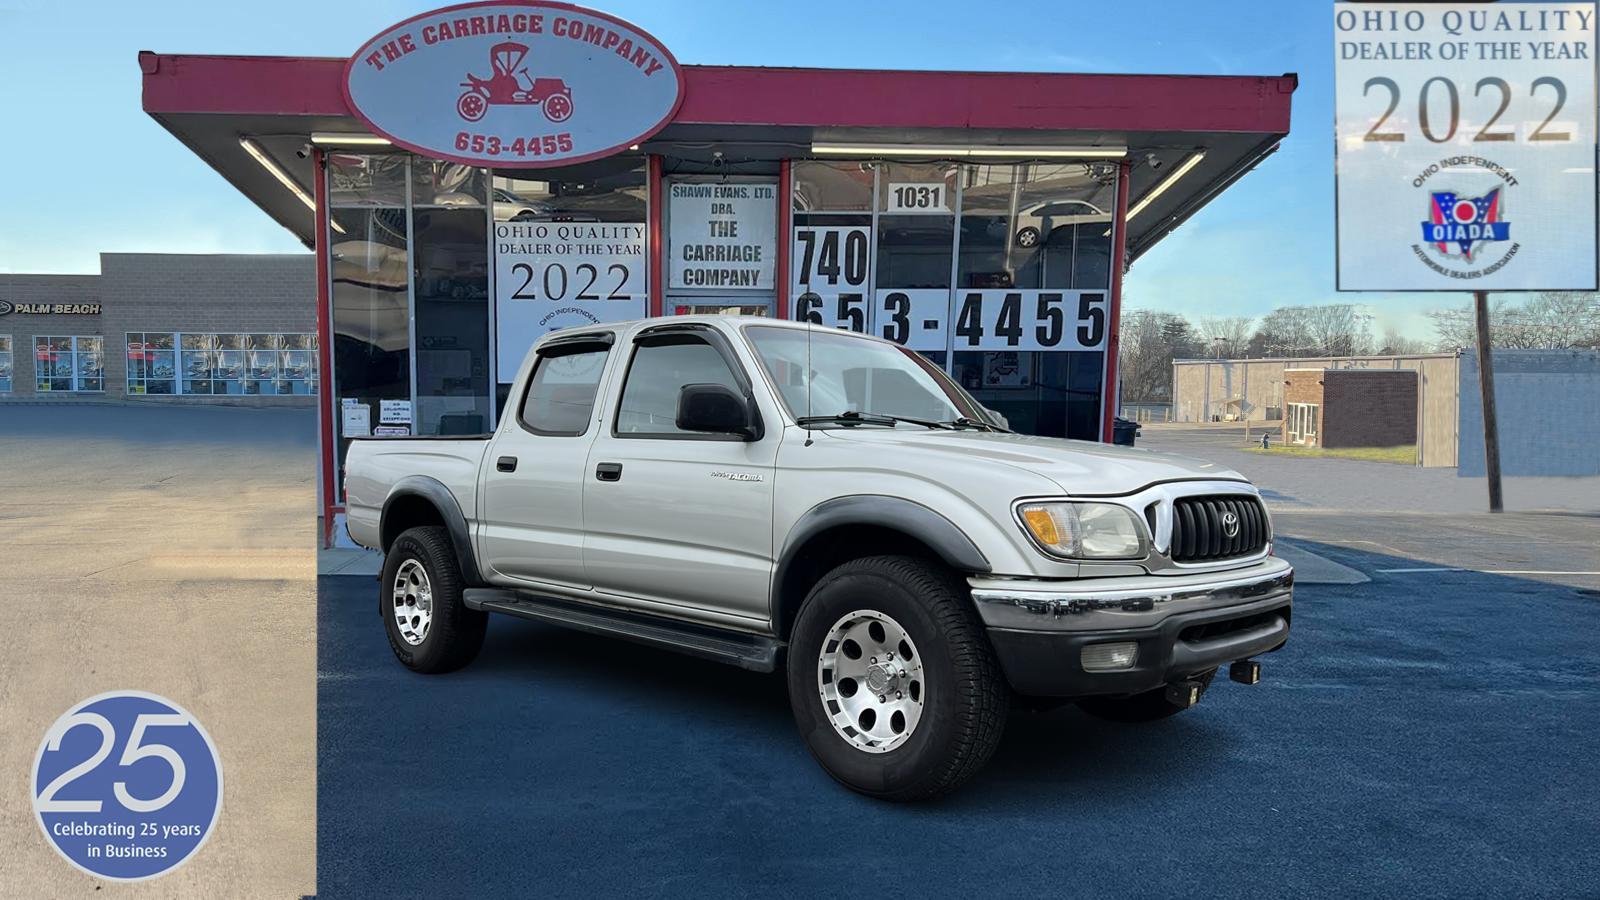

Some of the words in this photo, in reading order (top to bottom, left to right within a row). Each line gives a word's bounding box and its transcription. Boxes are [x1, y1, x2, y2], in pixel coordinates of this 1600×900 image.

[1336, 10, 1425, 31] OHIO
[1442, 10, 1592, 35] QUALITY
[366, 34, 416, 72] THE
[422, 14, 543, 46] CARRIAGE
[552, 17, 663, 77] COMPANY
[1340, 42, 1433, 60] DEALER
[1439, 42, 1469, 60] OF
[1475, 42, 1522, 60] THE
[1528, 42, 1589, 60] YEAR
[1363, 76, 1571, 143] 2022
[454, 132, 573, 156] 653-4455
[1412, 164, 1440, 188] OHIO
[1440, 155, 1519, 188] INDEPENDENT
[672, 186, 712, 198] SHAWN
[754, 186, 774, 199] LTD.
[894, 186, 940, 208] 1031
[711, 203, 736, 215] DBA.
[497, 226, 548, 239] OHIO
[558, 226, 644, 241] QUALITY
[708, 221, 738, 238] THE
[1432, 224, 1495, 241] OIADA
[500, 244, 551, 255] DEALER
[555, 244, 572, 255] OF
[576, 244, 603, 255] THE
[607, 244, 641, 255] YEAR
[683, 244, 762, 262] CARRIAGE
[797, 230, 867, 286] 740
[1411, 243, 1449, 277] AUTOMOBILE
[1449, 270, 1482, 280] DEALERS
[1482, 242, 1520, 277] ASSOCIATION
[511, 263, 631, 301] 2022
[683, 268, 760, 286] COMPANY
[15, 304, 50, 314] PALM
[54, 304, 99, 314] BEACH
[539, 311, 555, 326] OHIO
[729, 472, 763, 482] TACOMA
